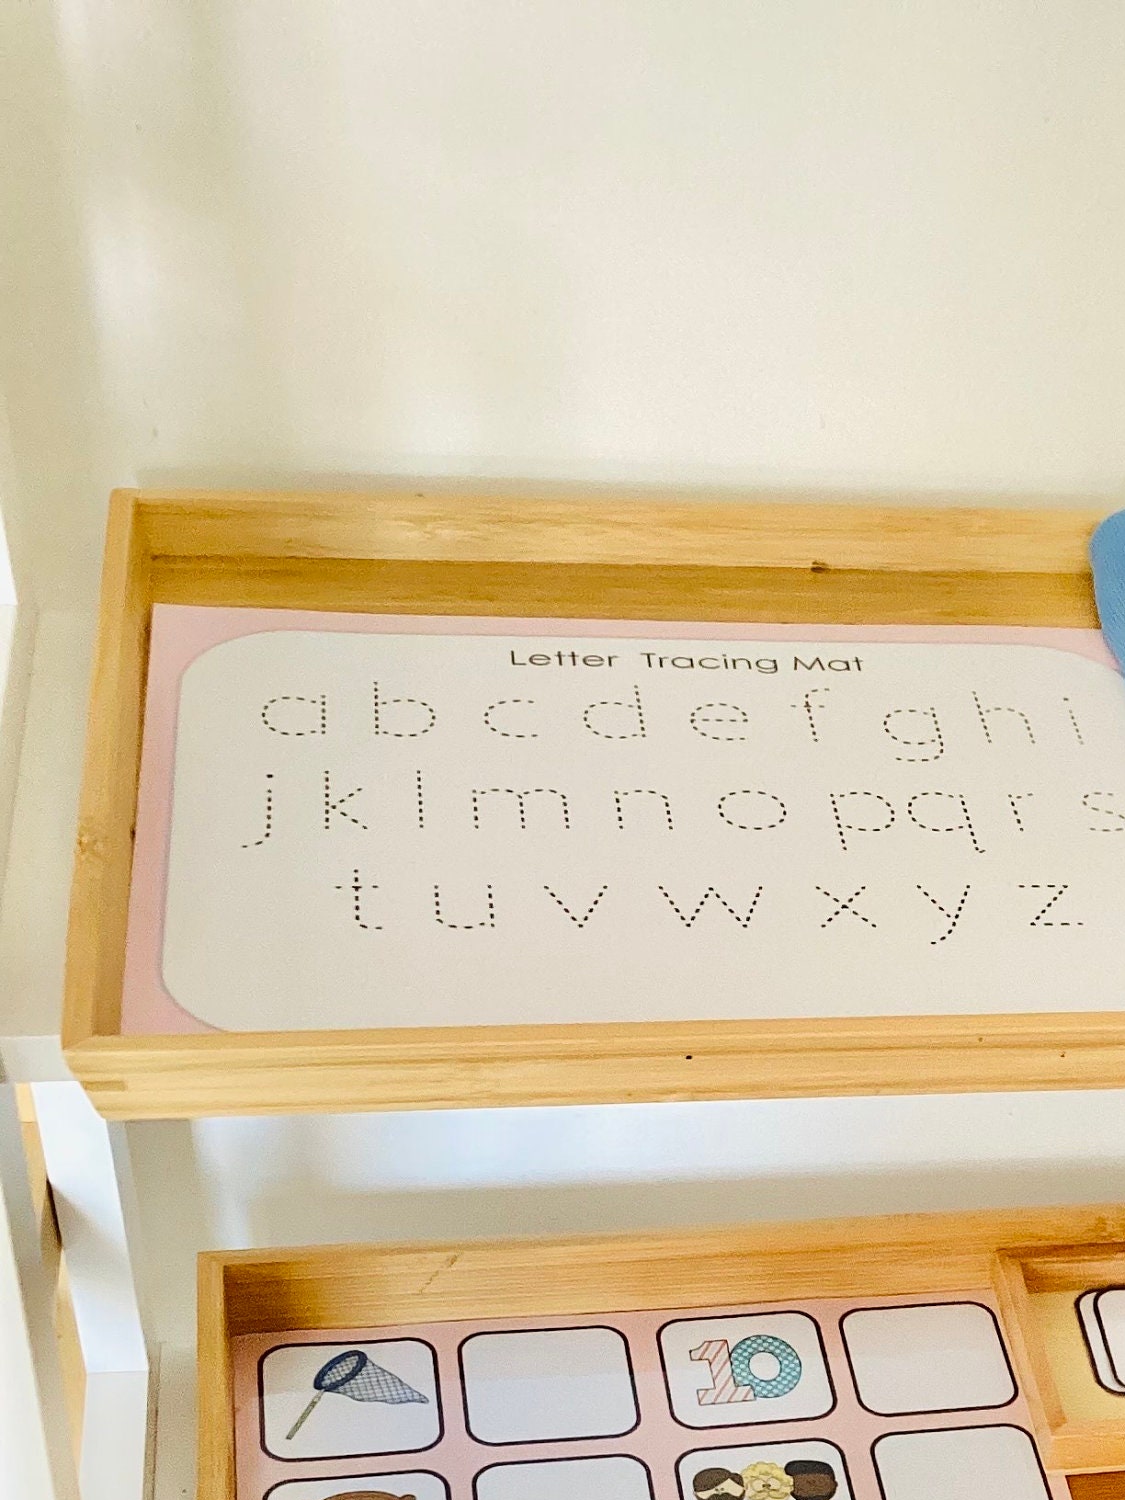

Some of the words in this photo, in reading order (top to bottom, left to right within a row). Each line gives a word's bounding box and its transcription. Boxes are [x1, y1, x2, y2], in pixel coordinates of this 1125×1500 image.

[510, 649, 619, 669] Letter
[641, 651, 779, 675] Tracing
[793, 655, 864, 673] Mat
[261, 694, 327, 737] a
[374, 680, 437, 738] b
[483, 698, 540, 738] c
[583, 684, 647, 739] d
[689, 702, 749, 741] e
[790, 687, 831, 743] f
[883, 705, 944, 762] g
[971, 690, 1036, 745] h
[241, 773, 275, 849] j
[324, 769, 369, 830] k
[472, 787, 571, 830] m
[614, 789, 674, 830] n
[717, 789, 788, 830] o
[1008, 792, 1035, 832] r
[334, 868, 384, 930] t
[434, 884, 495, 929] u
[543, 885, 609, 928] v
[658, 885, 763, 928] w
[815, 885, 877, 928] x
[916, 884, 971, 945] y
[1018, 884, 1085, 927] z
[688, 1333, 803, 1407] 10
